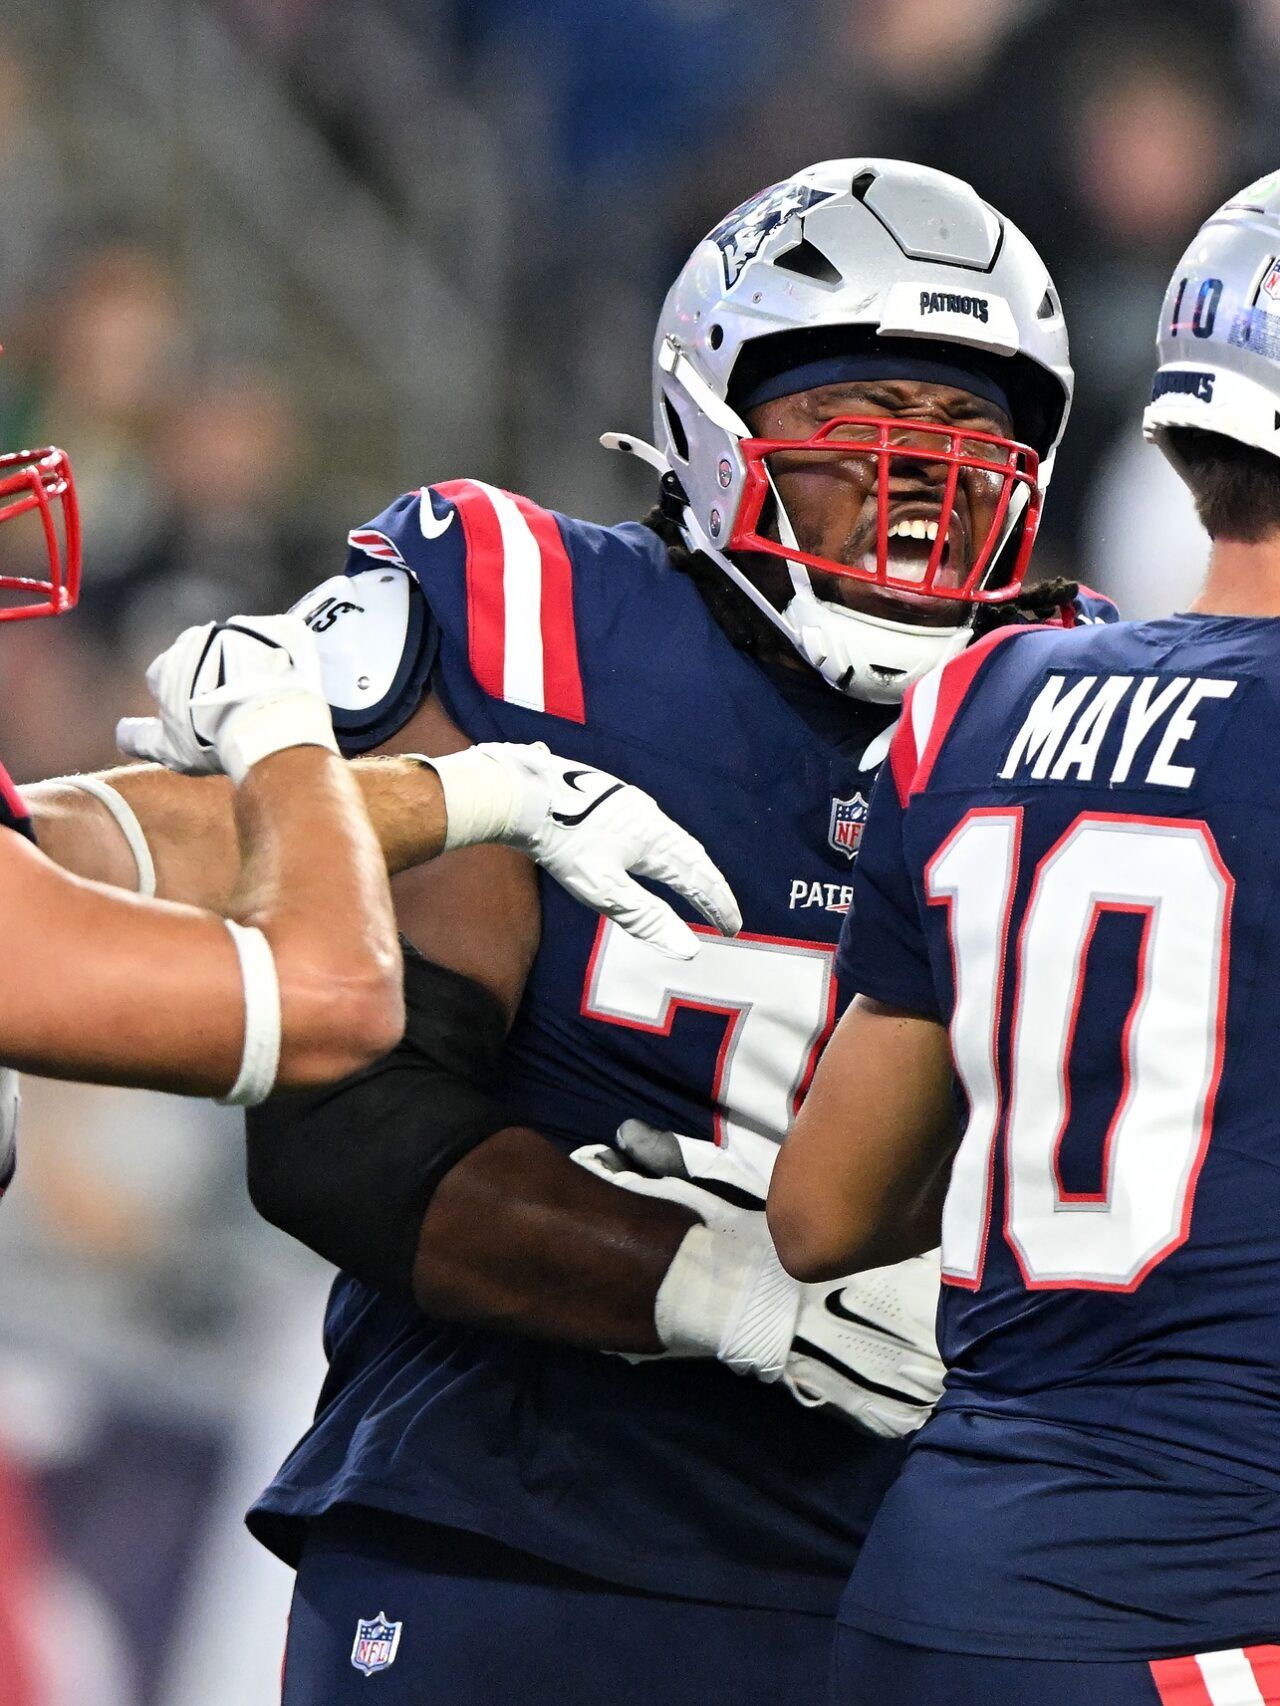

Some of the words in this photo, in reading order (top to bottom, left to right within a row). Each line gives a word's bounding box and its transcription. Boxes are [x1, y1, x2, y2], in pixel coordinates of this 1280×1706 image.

[920, 291, 988, 324] PATRIOTS
[1171, 278, 1223, 338] 10
[996, 675, 1238, 788] MAYE
[924, 805, 1235, 1293] 10
[358, 1641, 386, 1664] NFL
